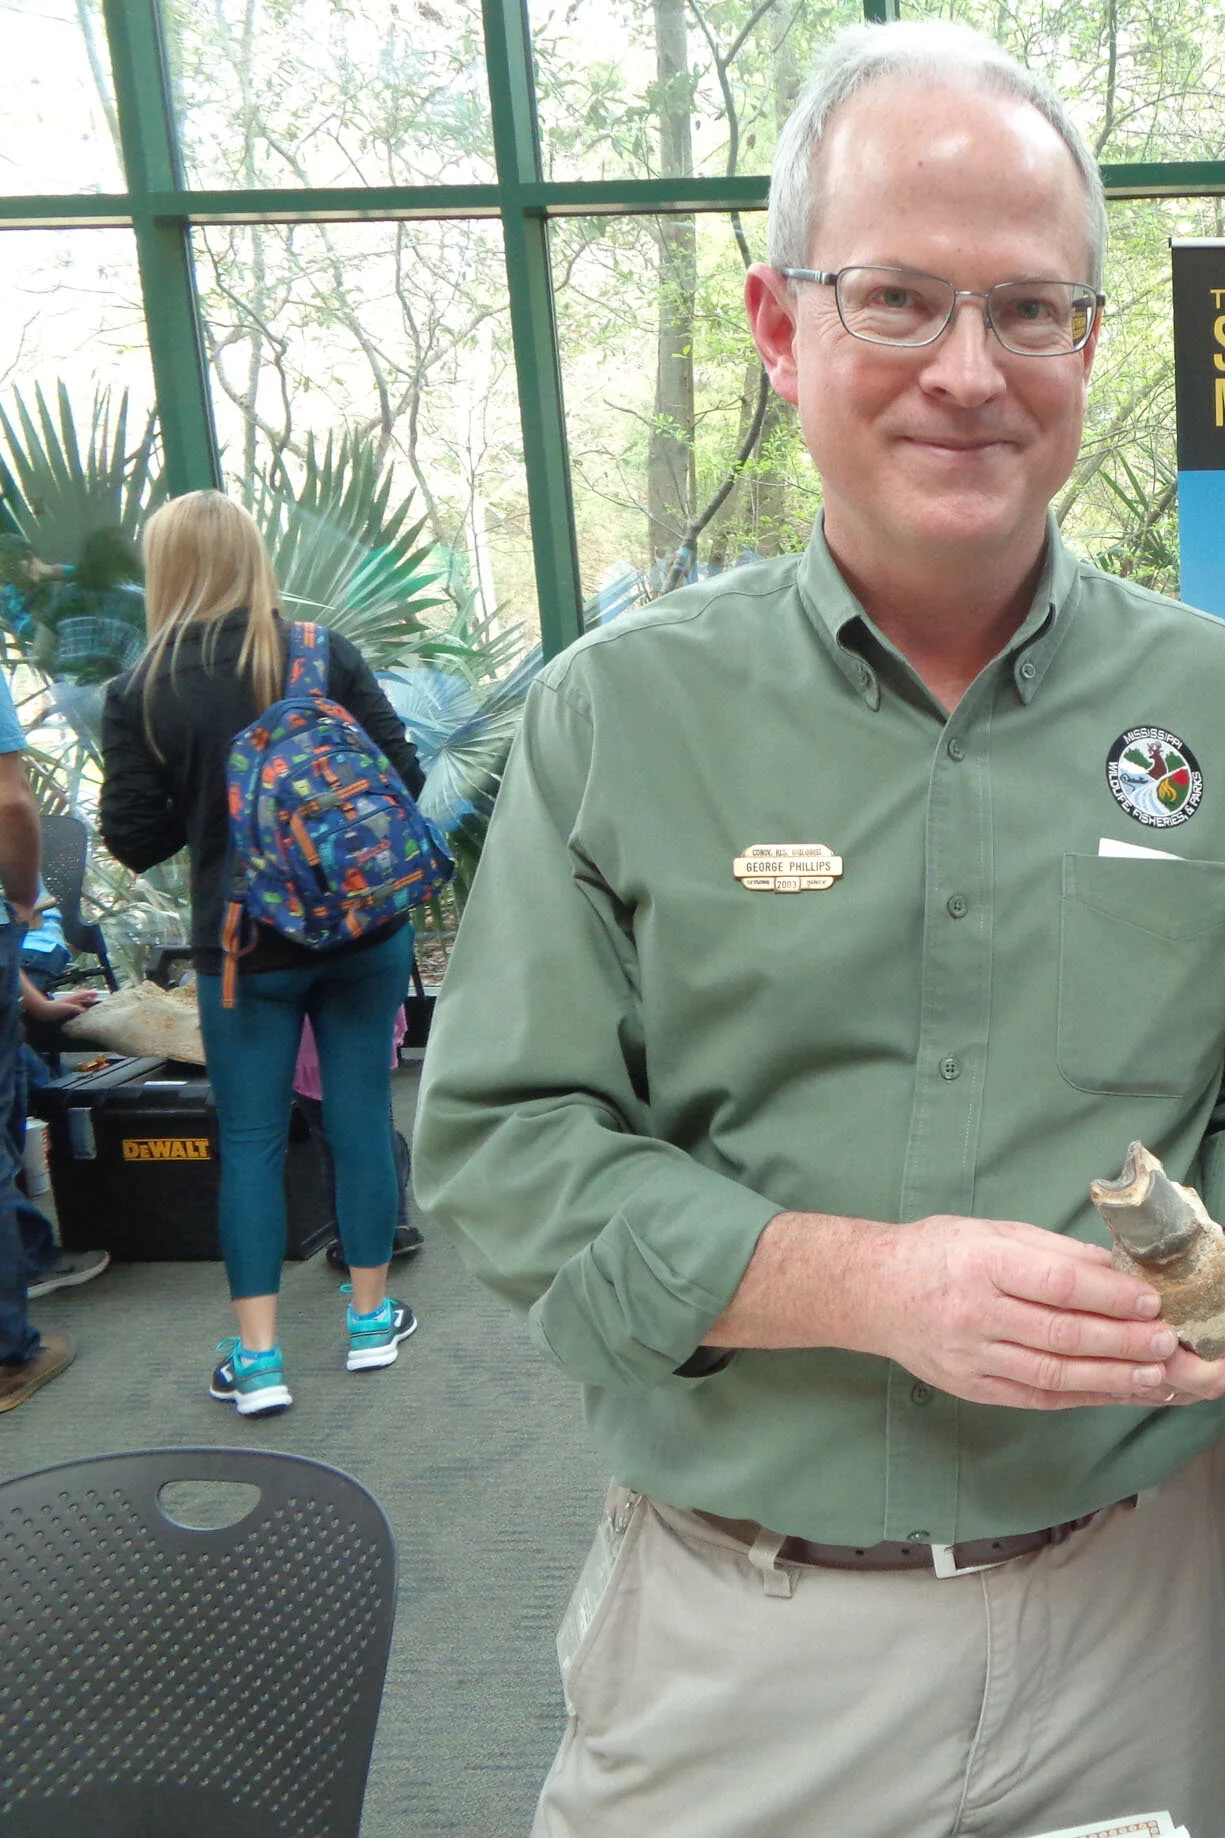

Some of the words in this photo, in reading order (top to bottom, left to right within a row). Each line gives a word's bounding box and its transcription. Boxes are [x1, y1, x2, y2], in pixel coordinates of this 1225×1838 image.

[1122, 727, 1183, 750] MISSISSIPPI
[1189, 771, 1203, 807] PARKS
[1184, 804, 1195, 816] &
[746, 861, 784, 873] GEORGE
[789, 861, 832, 872] PHILLIPS
[777, 880, 797, 889] 2003
